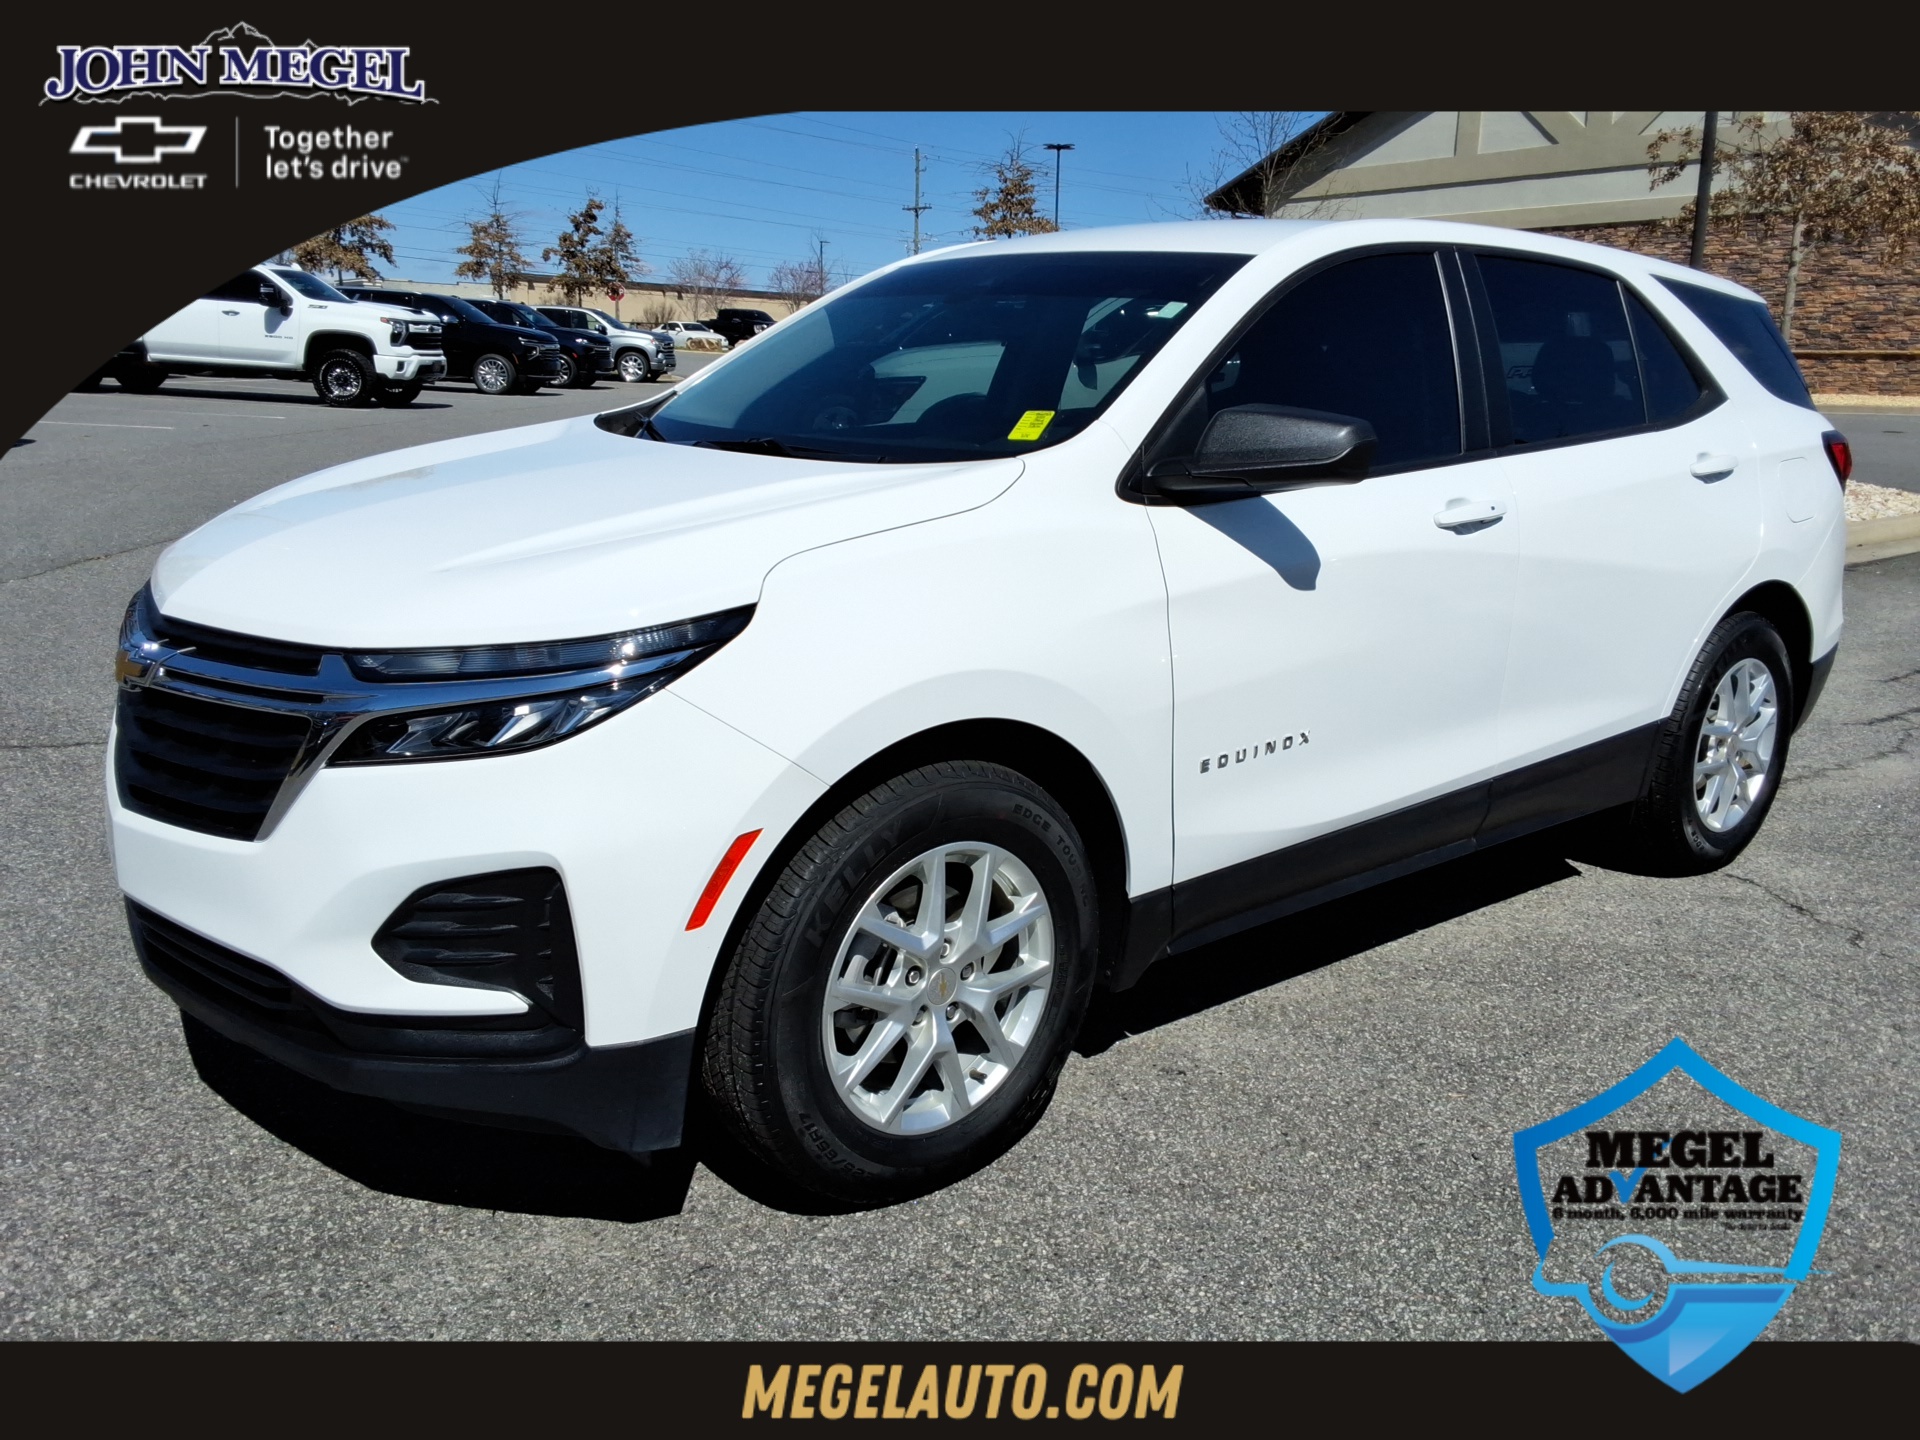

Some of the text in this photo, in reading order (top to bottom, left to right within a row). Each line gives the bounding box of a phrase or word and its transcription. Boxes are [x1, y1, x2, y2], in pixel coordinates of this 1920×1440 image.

[1199, 729, 1311, 774] EQUINOX
[1011, 803, 1052, 833] EDGE
[805, 818, 902, 949] KELLY
